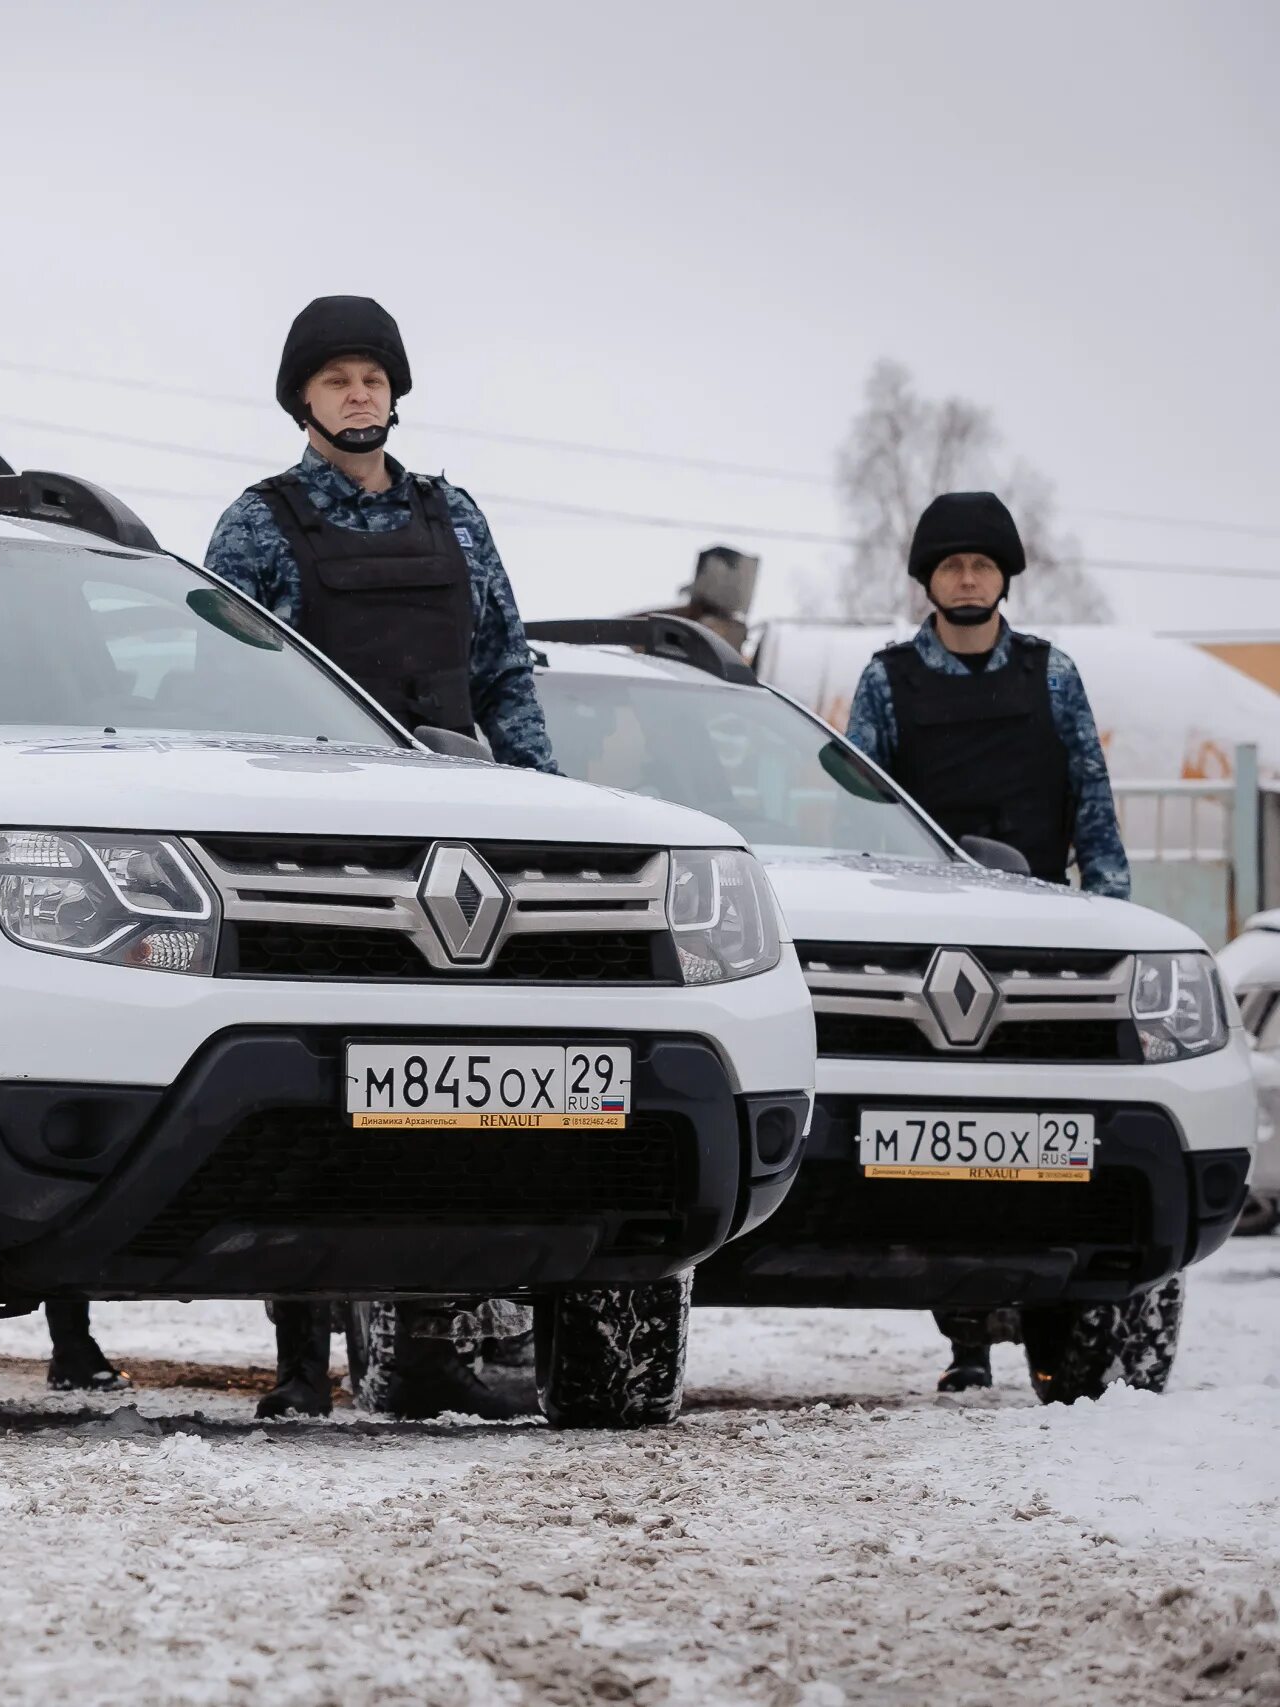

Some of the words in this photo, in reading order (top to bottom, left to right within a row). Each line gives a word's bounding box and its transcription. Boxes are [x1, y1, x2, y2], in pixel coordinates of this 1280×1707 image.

[571, 1053, 614, 1094] 29
[568, 1096, 600, 1110] RUS
[361, 1116, 403, 1126] Динамика
[405, 1117, 458, 1126] Архангельск
[480, 1114, 542, 1127] RENAULT
[1043, 1120, 1079, 1151] 29
[1041, 1154, 1068, 1165] RUS
[969, 1168, 1020, 1179] RENAULT
